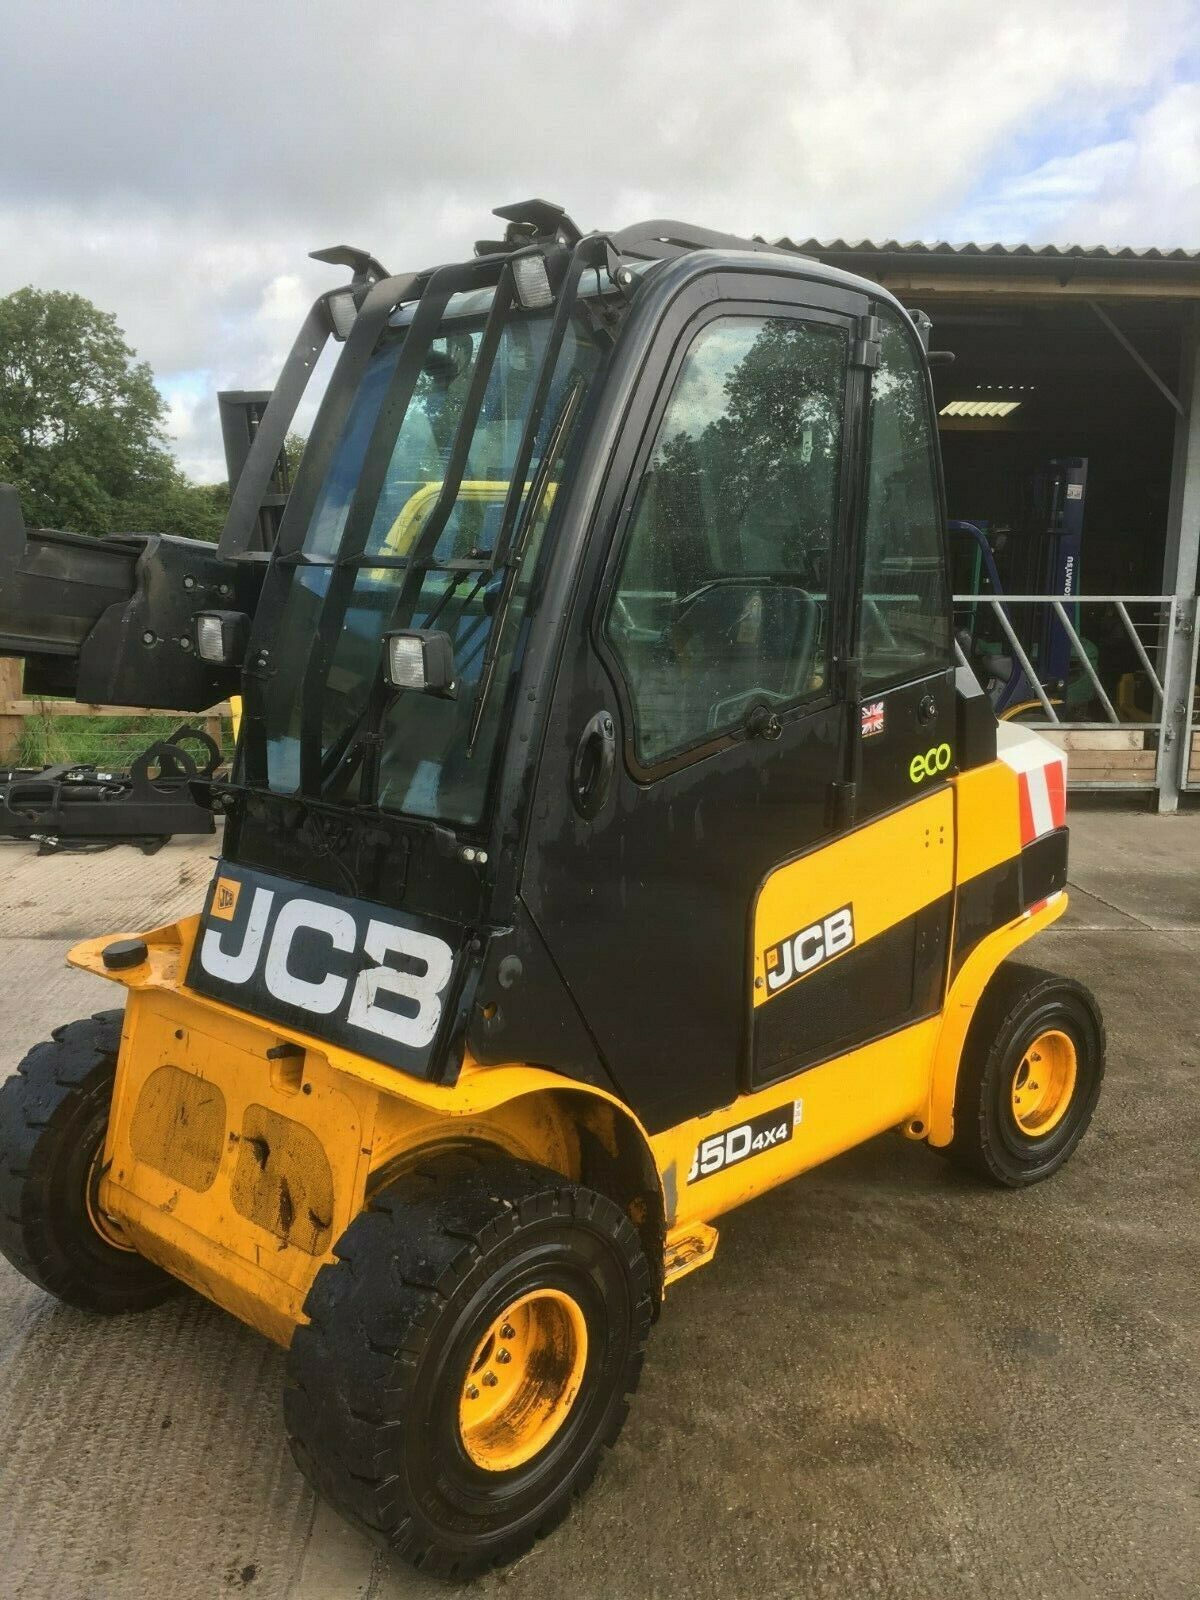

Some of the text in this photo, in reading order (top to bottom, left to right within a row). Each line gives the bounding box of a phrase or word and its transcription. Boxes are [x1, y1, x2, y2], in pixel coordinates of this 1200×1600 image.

[909, 743, 951, 783] eco
[201, 886, 454, 1048] JCB
[768, 909, 854, 989] JCB
